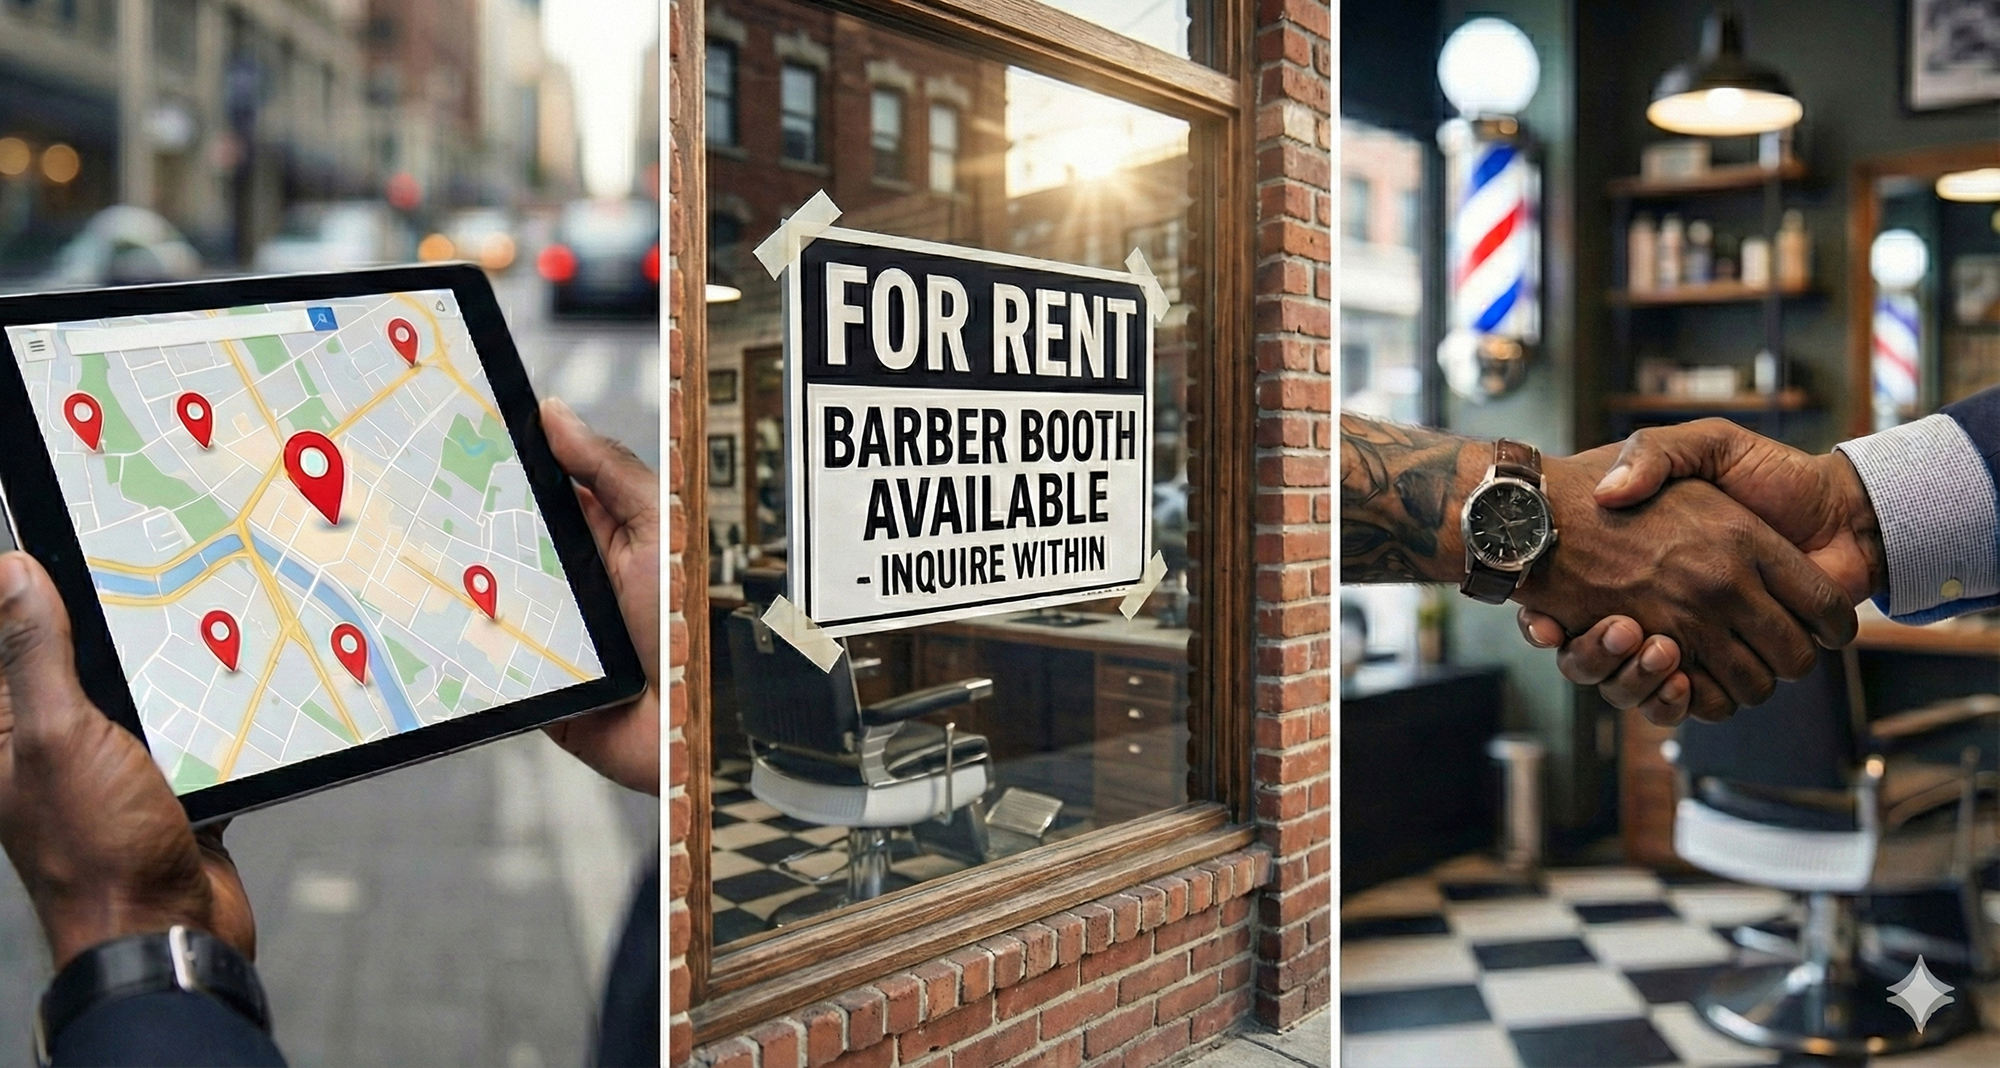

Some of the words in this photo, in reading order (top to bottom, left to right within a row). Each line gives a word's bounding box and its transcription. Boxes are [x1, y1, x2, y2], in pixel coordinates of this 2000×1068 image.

[826, 261, 970, 372] FOR
[994, 281, 1137, 379] RENT
[824, 406, 1008, 468] BARBER
[1021, 409, 1135, 463] BOOTH
[863, 471, 1109, 540] AVAILABLE
[882, 544, 1006, 596] INQUIRE
[1013, 536, 1105, 578] WITHIN
